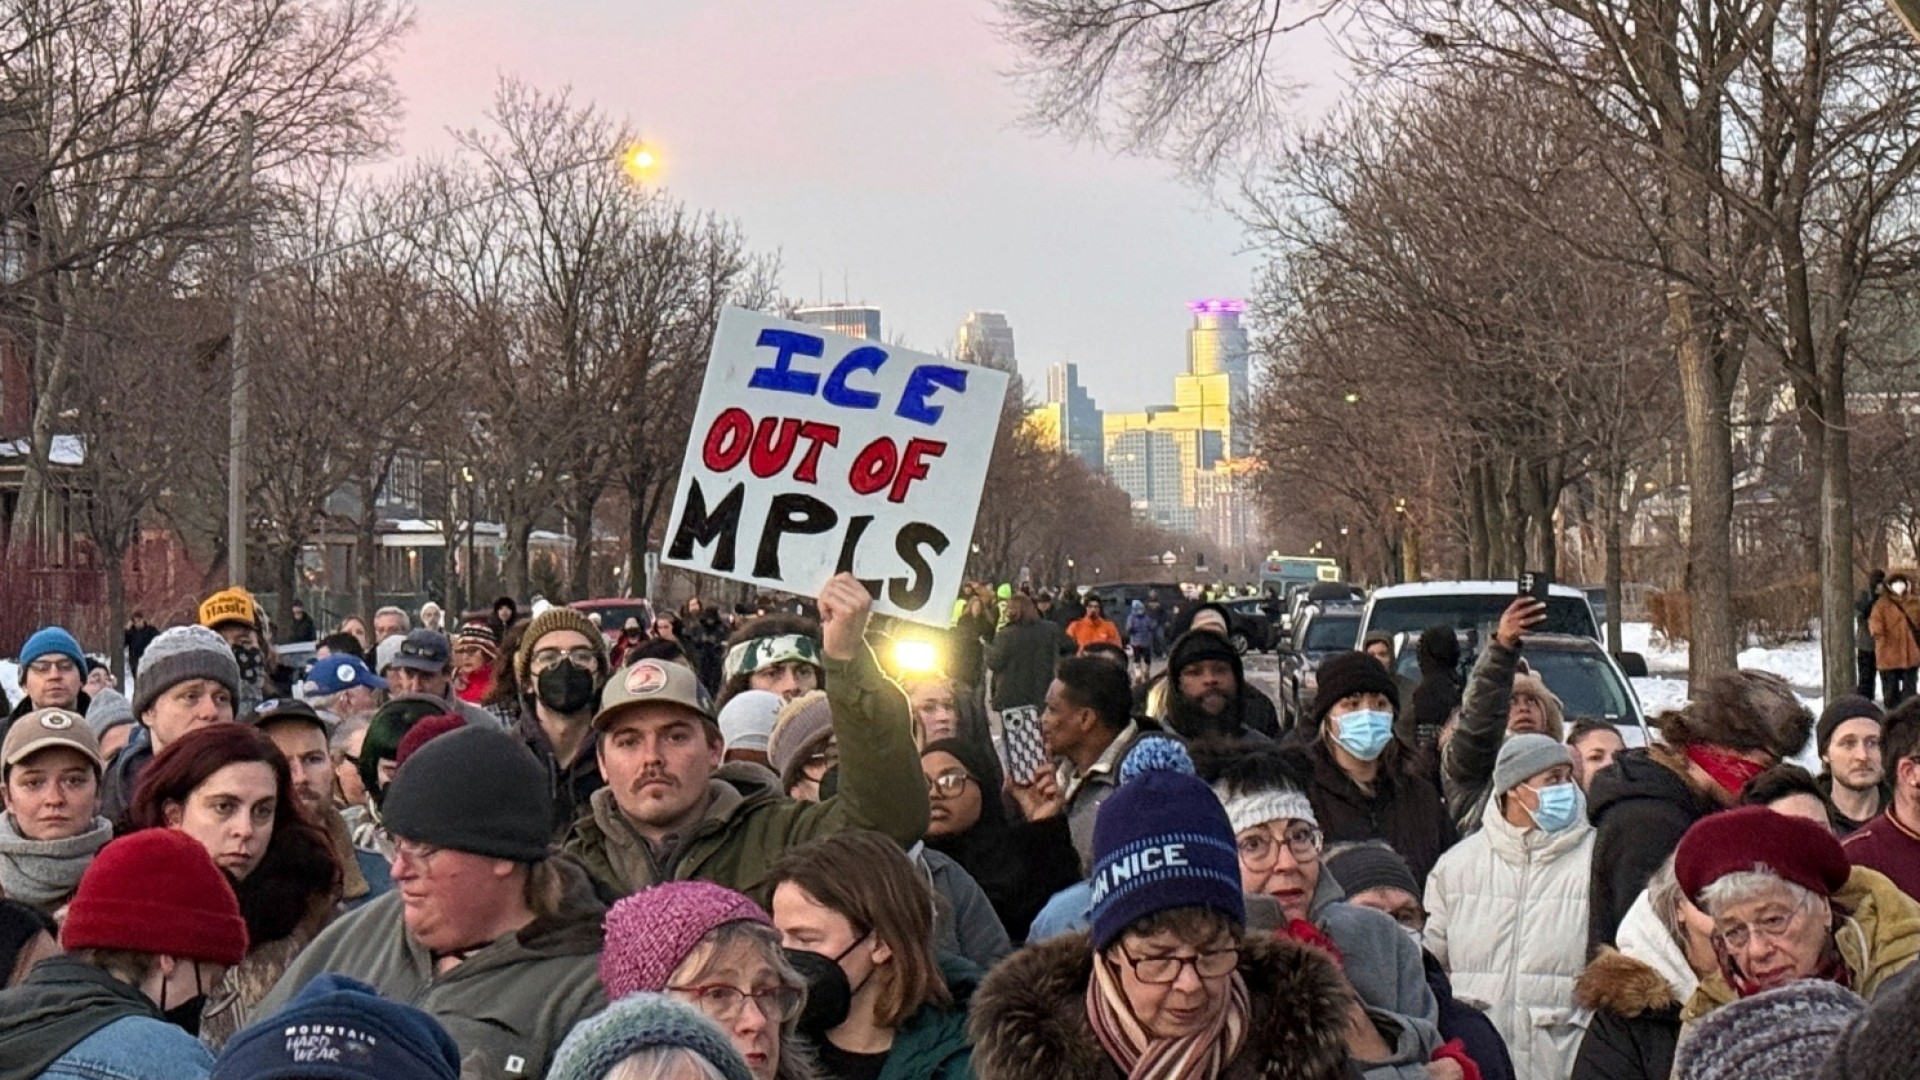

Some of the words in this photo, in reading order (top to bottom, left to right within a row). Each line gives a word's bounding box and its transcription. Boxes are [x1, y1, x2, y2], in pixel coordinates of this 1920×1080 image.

[748, 328, 968, 426] ICE
[703, 407, 840, 484] OUT
[849, 436, 947, 503] OF
[668, 476, 950, 611] MPLS
[1111, 844, 1189, 887] NICE
[285, 1024, 376, 1046] MOUNTAIN
[285, 1035, 331, 1051] HARD
[294, 1046, 342, 1062] WEAR
